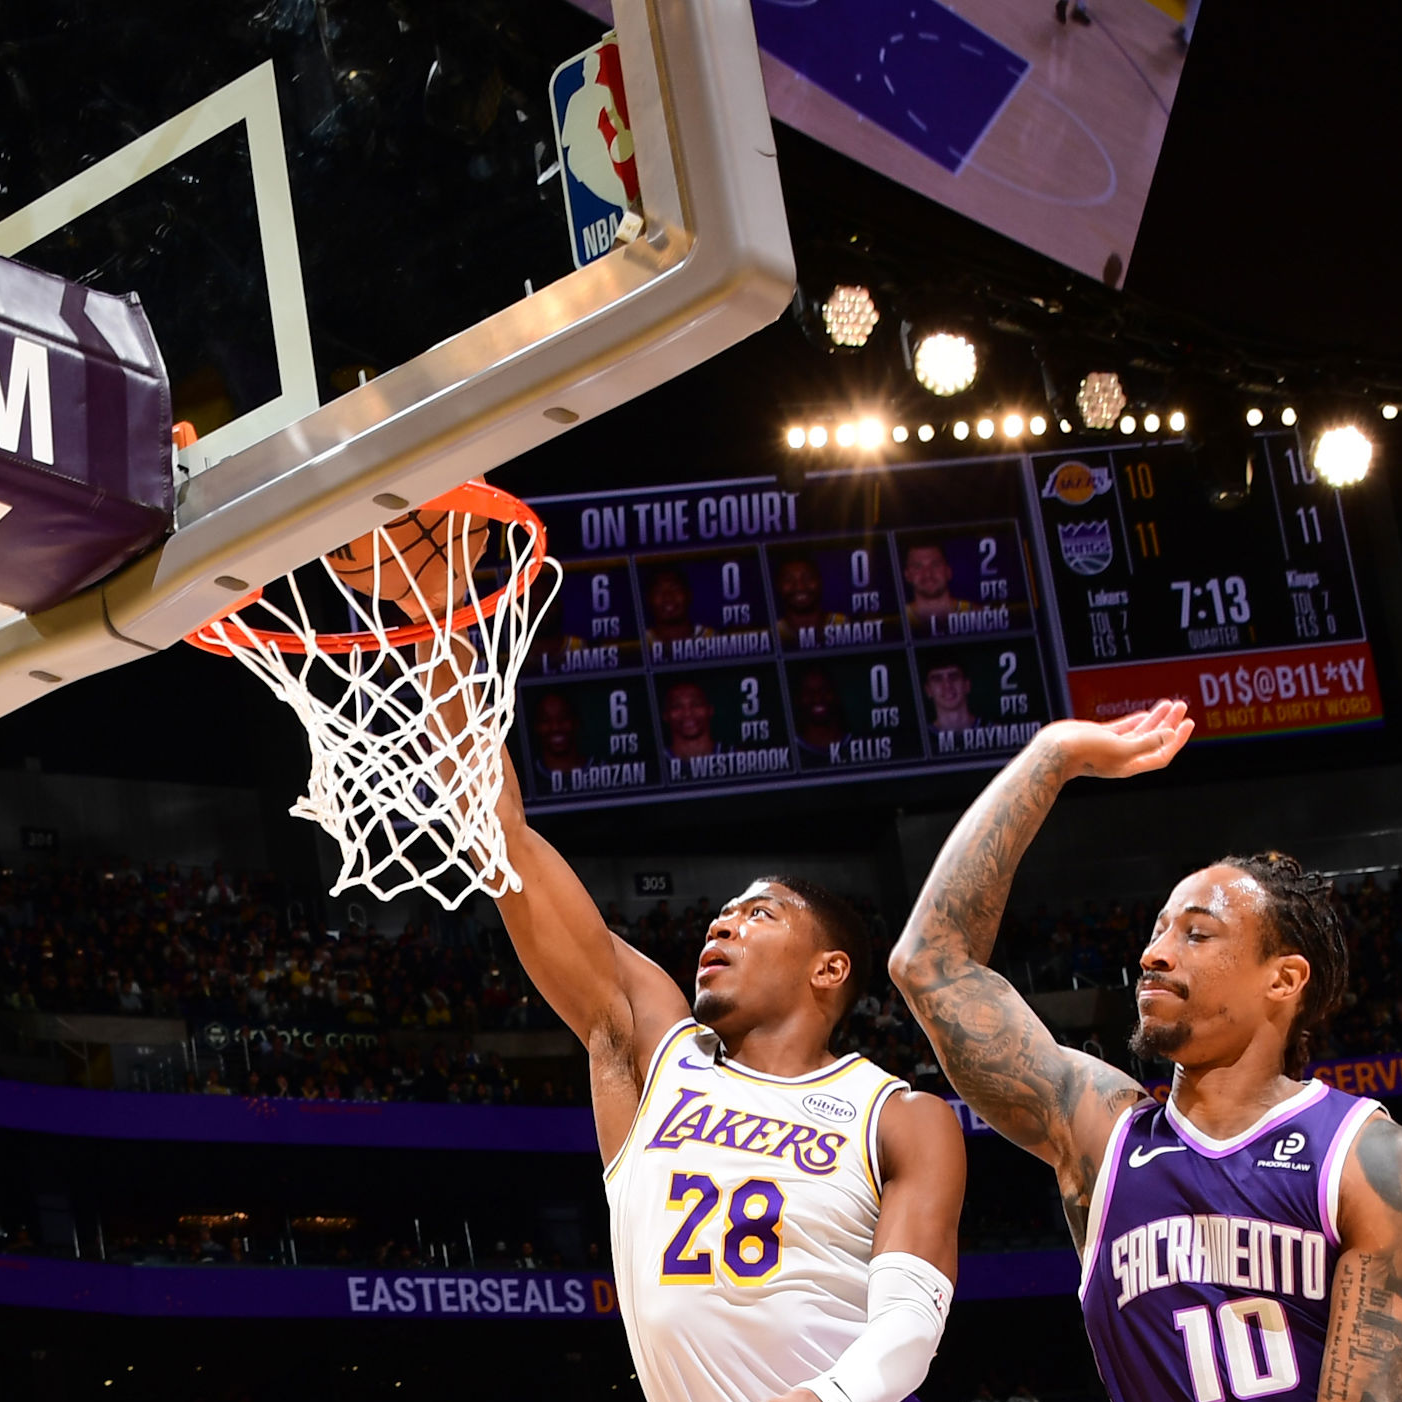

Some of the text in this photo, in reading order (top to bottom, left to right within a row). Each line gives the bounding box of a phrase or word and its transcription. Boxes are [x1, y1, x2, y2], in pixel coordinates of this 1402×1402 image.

[582, 211, 621, 260] NBA
[1124, 462, 1155, 499] 10
[581, 489, 800, 550] ON THE COURT
[1297, 506, 1323, 545] 11
[1135, 520, 1160, 558] 11
[851, 549, 869, 587] 0
[979, 537, 997, 575] 2
[591, 574, 610, 610] 6
[722, 561, 740, 598] 0
[980, 579, 1008, 599] PTS
[1285, 569, 1320, 590] Kings
[851, 592, 879, 612] PTS
[1087, 588, 1130, 608] Lakers
[1170, 575, 1251, 630] 7:13
[591, 616, 620, 638] PTS
[722, 603, 750, 625] PTS
[948, 604, 1010, 633] DONČIĆ
[671, 629, 771, 660] HACHIMURA
[799, 618, 884, 648] M. SMART
[1092, 634, 1117, 658] FLS
[1187, 625, 1240, 650] QUARTER
[560, 644, 619, 671] JAMES
[999, 651, 1018, 691] 2
[740, 677, 760, 717] 3
[870, 664, 889, 703] 0
[609, 689, 628, 730] 6
[871, 707, 900, 728] PTS
[1000, 694, 1028, 715] PTS
[1204, 695, 1372, 730] IS NOT A DIRTY WORD
[610, 733, 638, 756] PTS
[741, 720, 770, 742] PTS
[938, 730, 961, 754] M.
[670, 746, 790, 781] R. WESTBROOK
[829, 735, 892, 765] K. ELLIS
[550, 769, 568, 793] D.
[641, 875, 667, 891] 305
[807, 1096, 854, 1120] bibigo
[644, 1087, 850, 1176] LAKERS
[1291, 1161, 1311, 1172] LAW
[659, 1169, 788, 1287] 28
[1110, 1213, 1329, 1312] SACRAMENTO
[347, 1275, 586, 1316] EASTERSEALS
